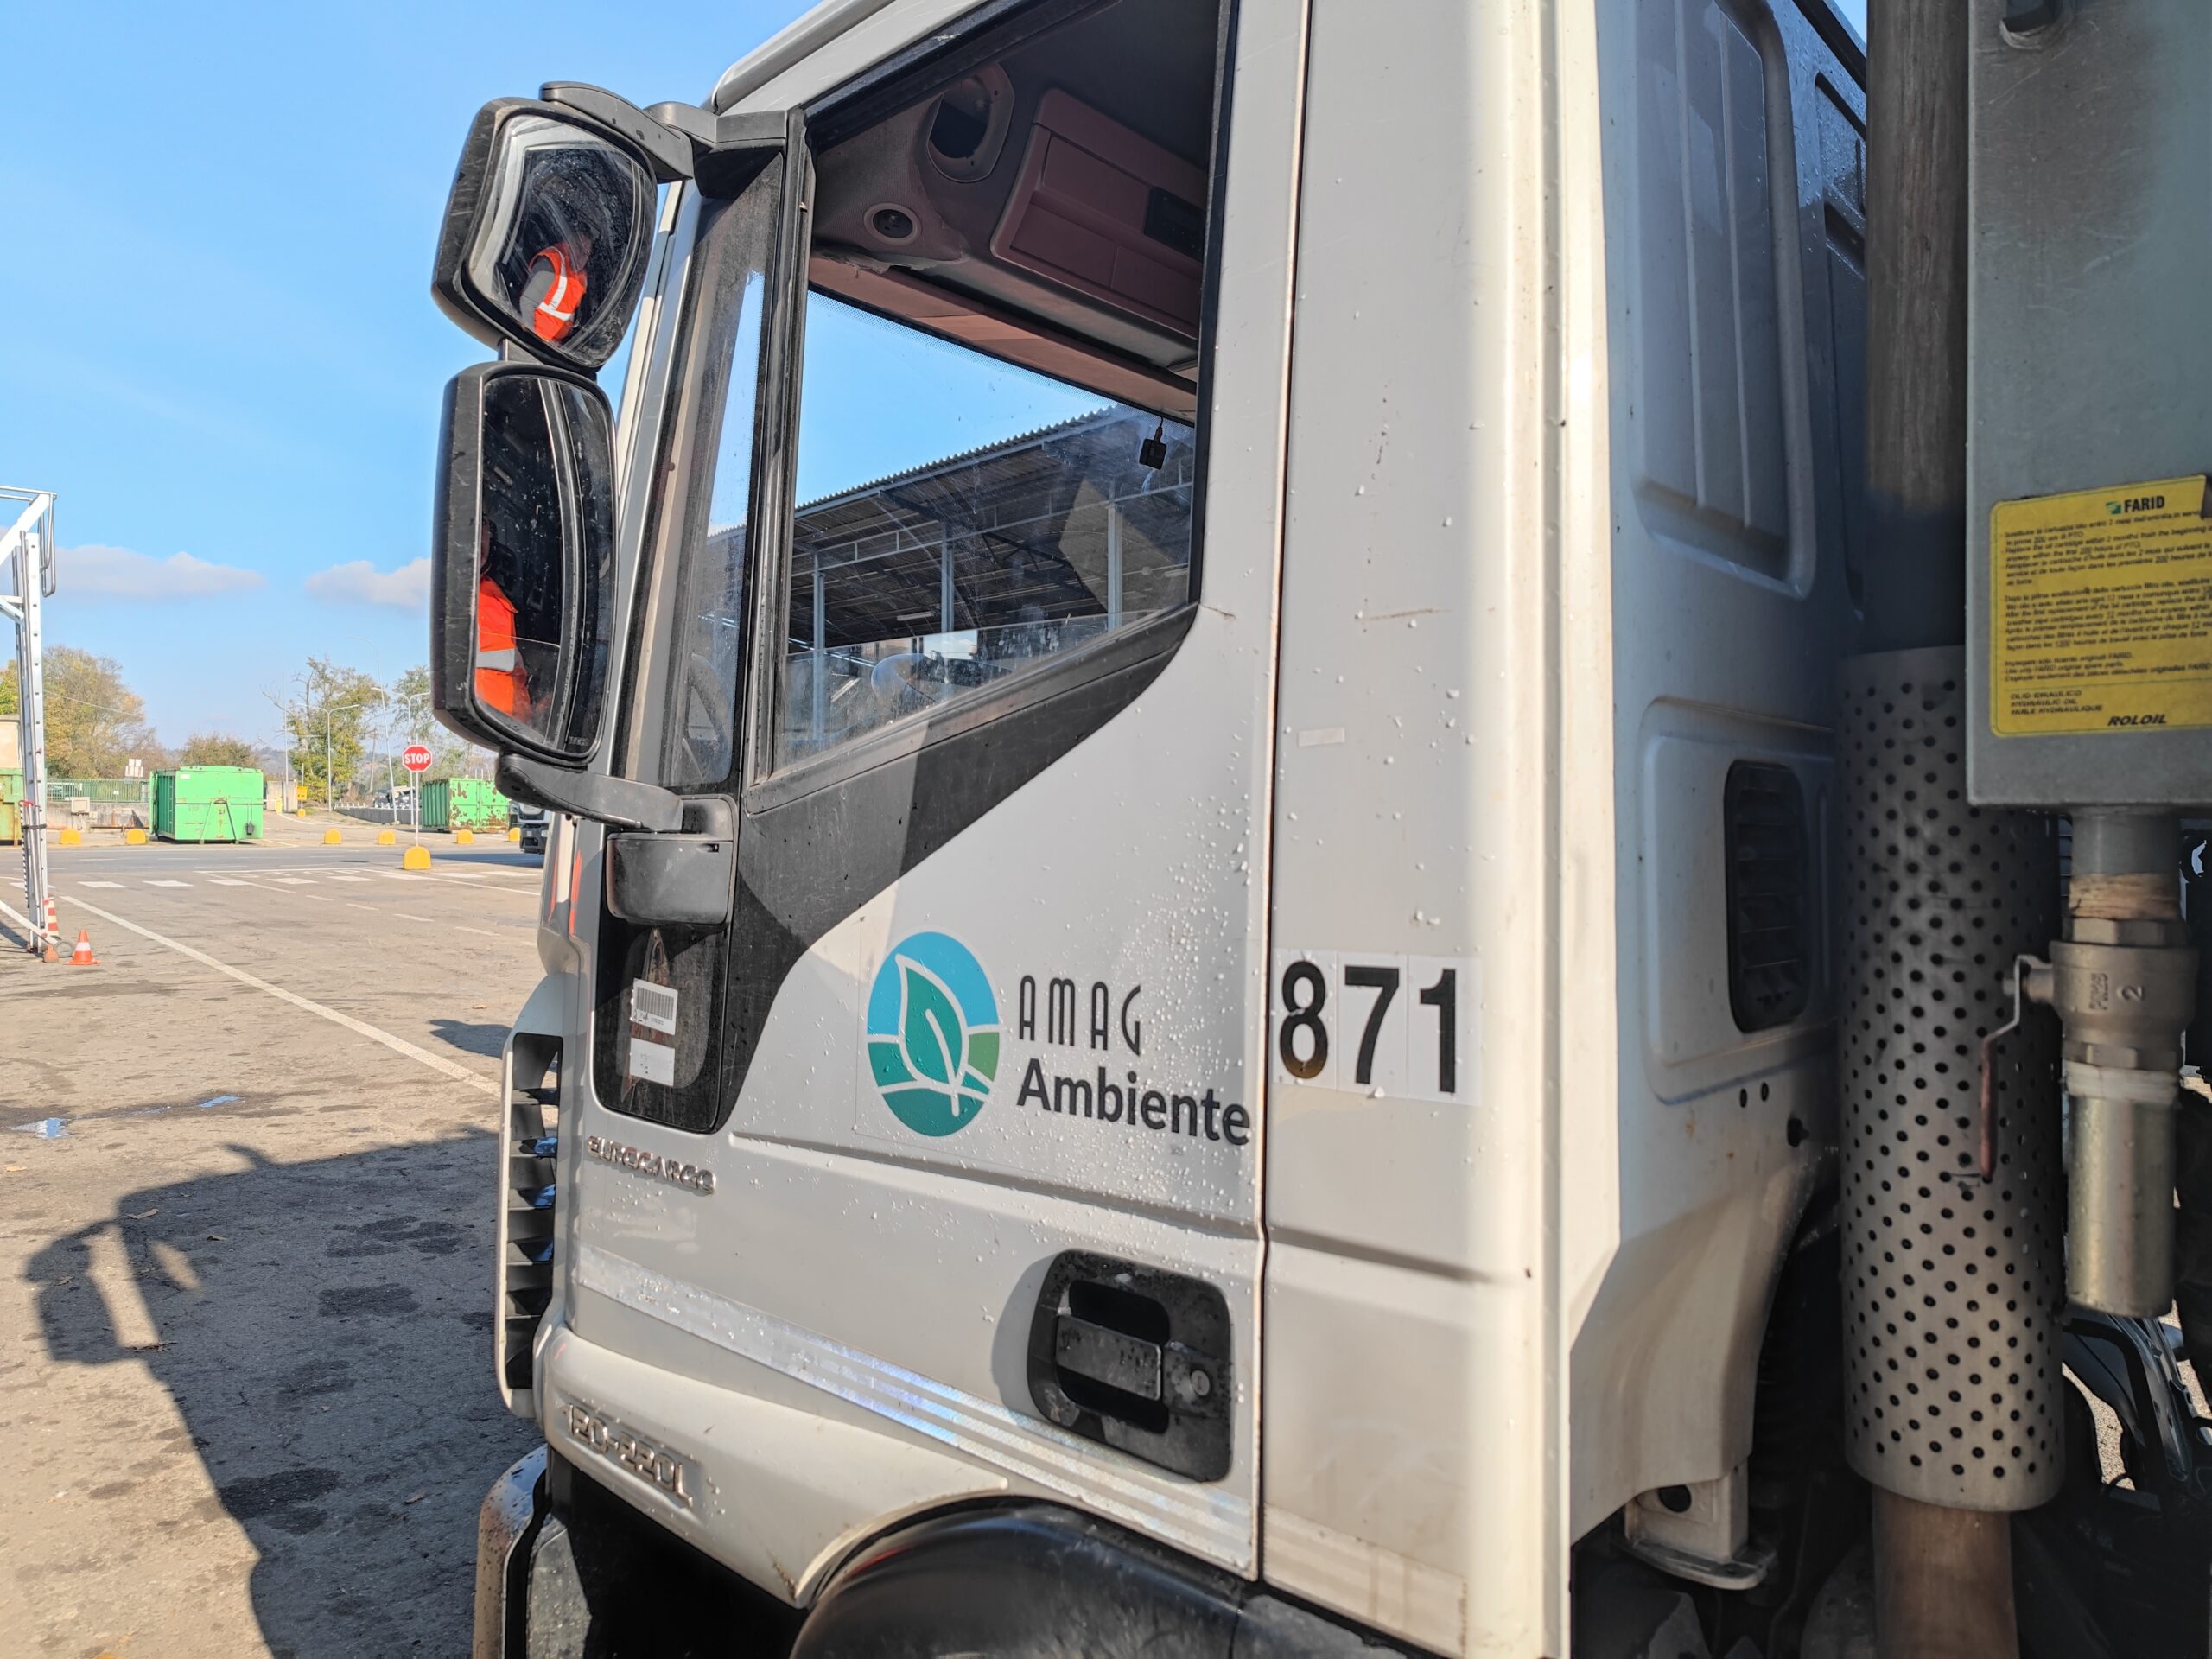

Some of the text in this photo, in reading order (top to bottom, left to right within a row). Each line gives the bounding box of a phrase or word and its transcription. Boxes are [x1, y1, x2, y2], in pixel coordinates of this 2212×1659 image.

[2124, 495, 2165, 512] FARID
[2107, 714, 2167, 726] ROLOIL
[404, 753, 431, 765] STOP
[1019, 974, 1143, 1056] AMAG
[1279, 959, 1458, 1095] 871
[1016, 1058, 1251, 1146] Ambiente
[586, 1135, 717, 1195] EUROCARGO
[568, 1402, 694, 1509] 120-220L
